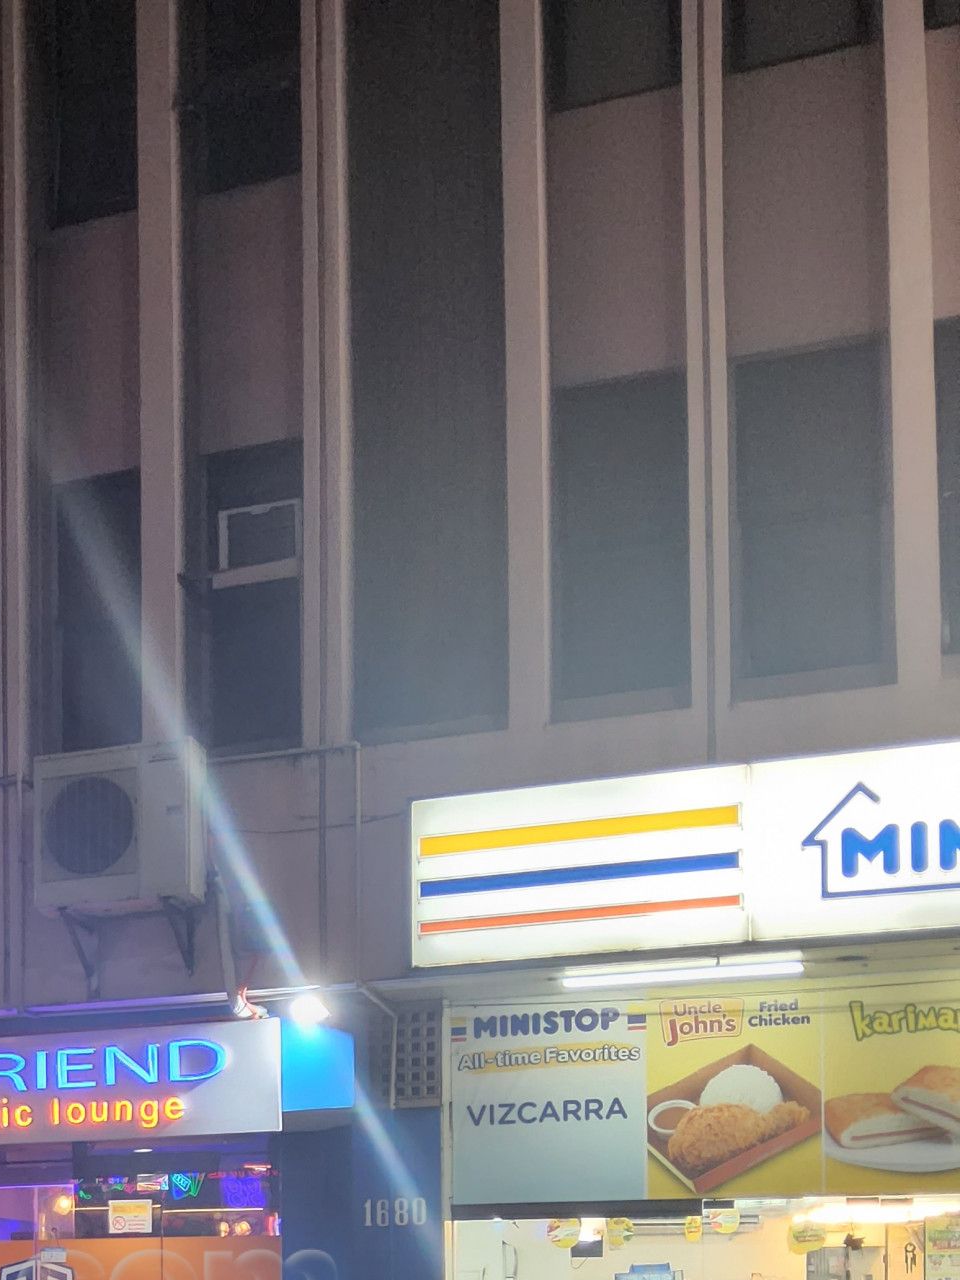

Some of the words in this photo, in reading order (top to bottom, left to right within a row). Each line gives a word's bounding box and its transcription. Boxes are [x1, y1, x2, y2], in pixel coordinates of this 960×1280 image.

[674, 1002, 723, 1018] Uncle
[748, 1013, 811, 1028] Chicken
[759, 999, 799, 1013] Fried
[473, 1007, 620, 1040] MINISTOP
[666, 1014, 737, 1047] John's
[457, 1050, 541, 1072] All-time
[544, 1044, 641, 1064] Favorites
[51, 1095, 186, 1130] lounge
[466, 1096, 628, 1127] VIZCARRA
